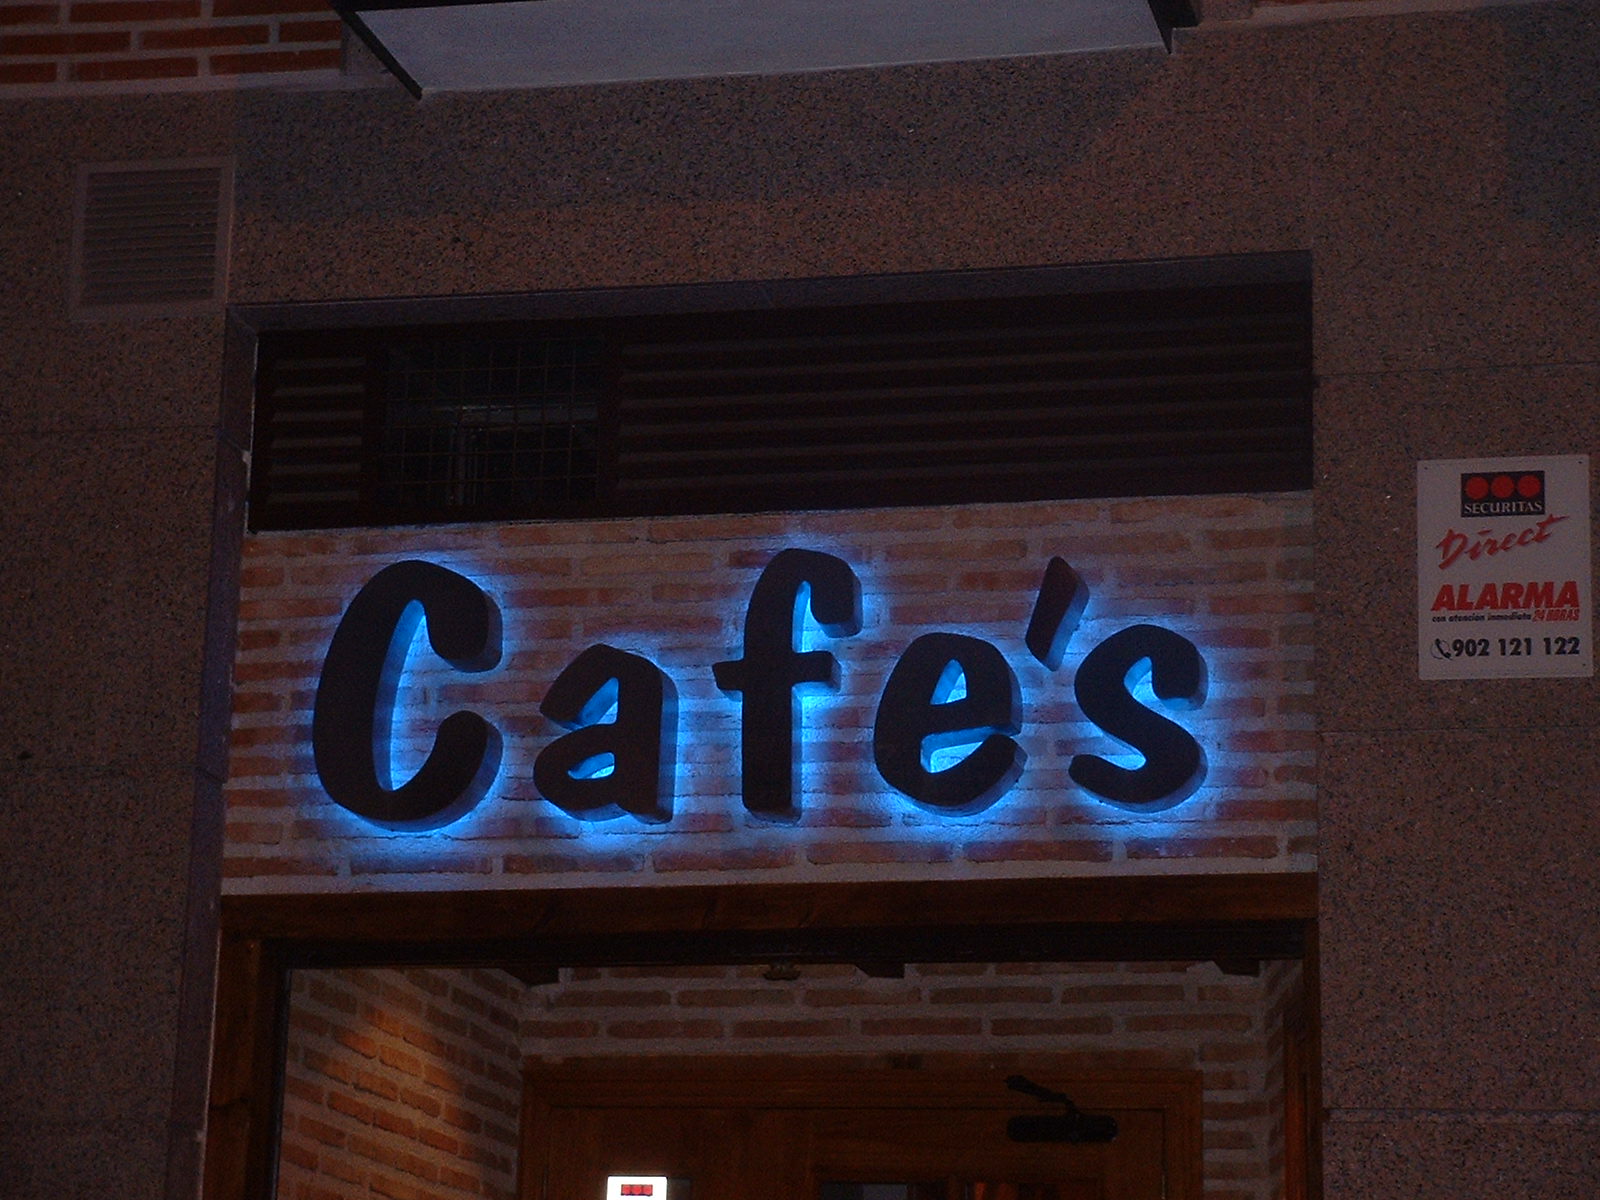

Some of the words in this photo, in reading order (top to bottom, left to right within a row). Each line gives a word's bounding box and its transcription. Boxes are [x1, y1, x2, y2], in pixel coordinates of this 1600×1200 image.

[1464, 501, 1542, 514] SECURITAS
[1436, 514, 1569, 569] Direct
[1431, 581, 1579, 611] ALARMA
[1533, 609, 1545, 622] 24
[1546, 609, 1580, 621] HORAS
[1452, 639, 1490, 657] 902
[1498, 638, 1532, 656] 121
[1543, 637, 1580, 655] 122
[313, 548, 1209, 830] Cafe's
